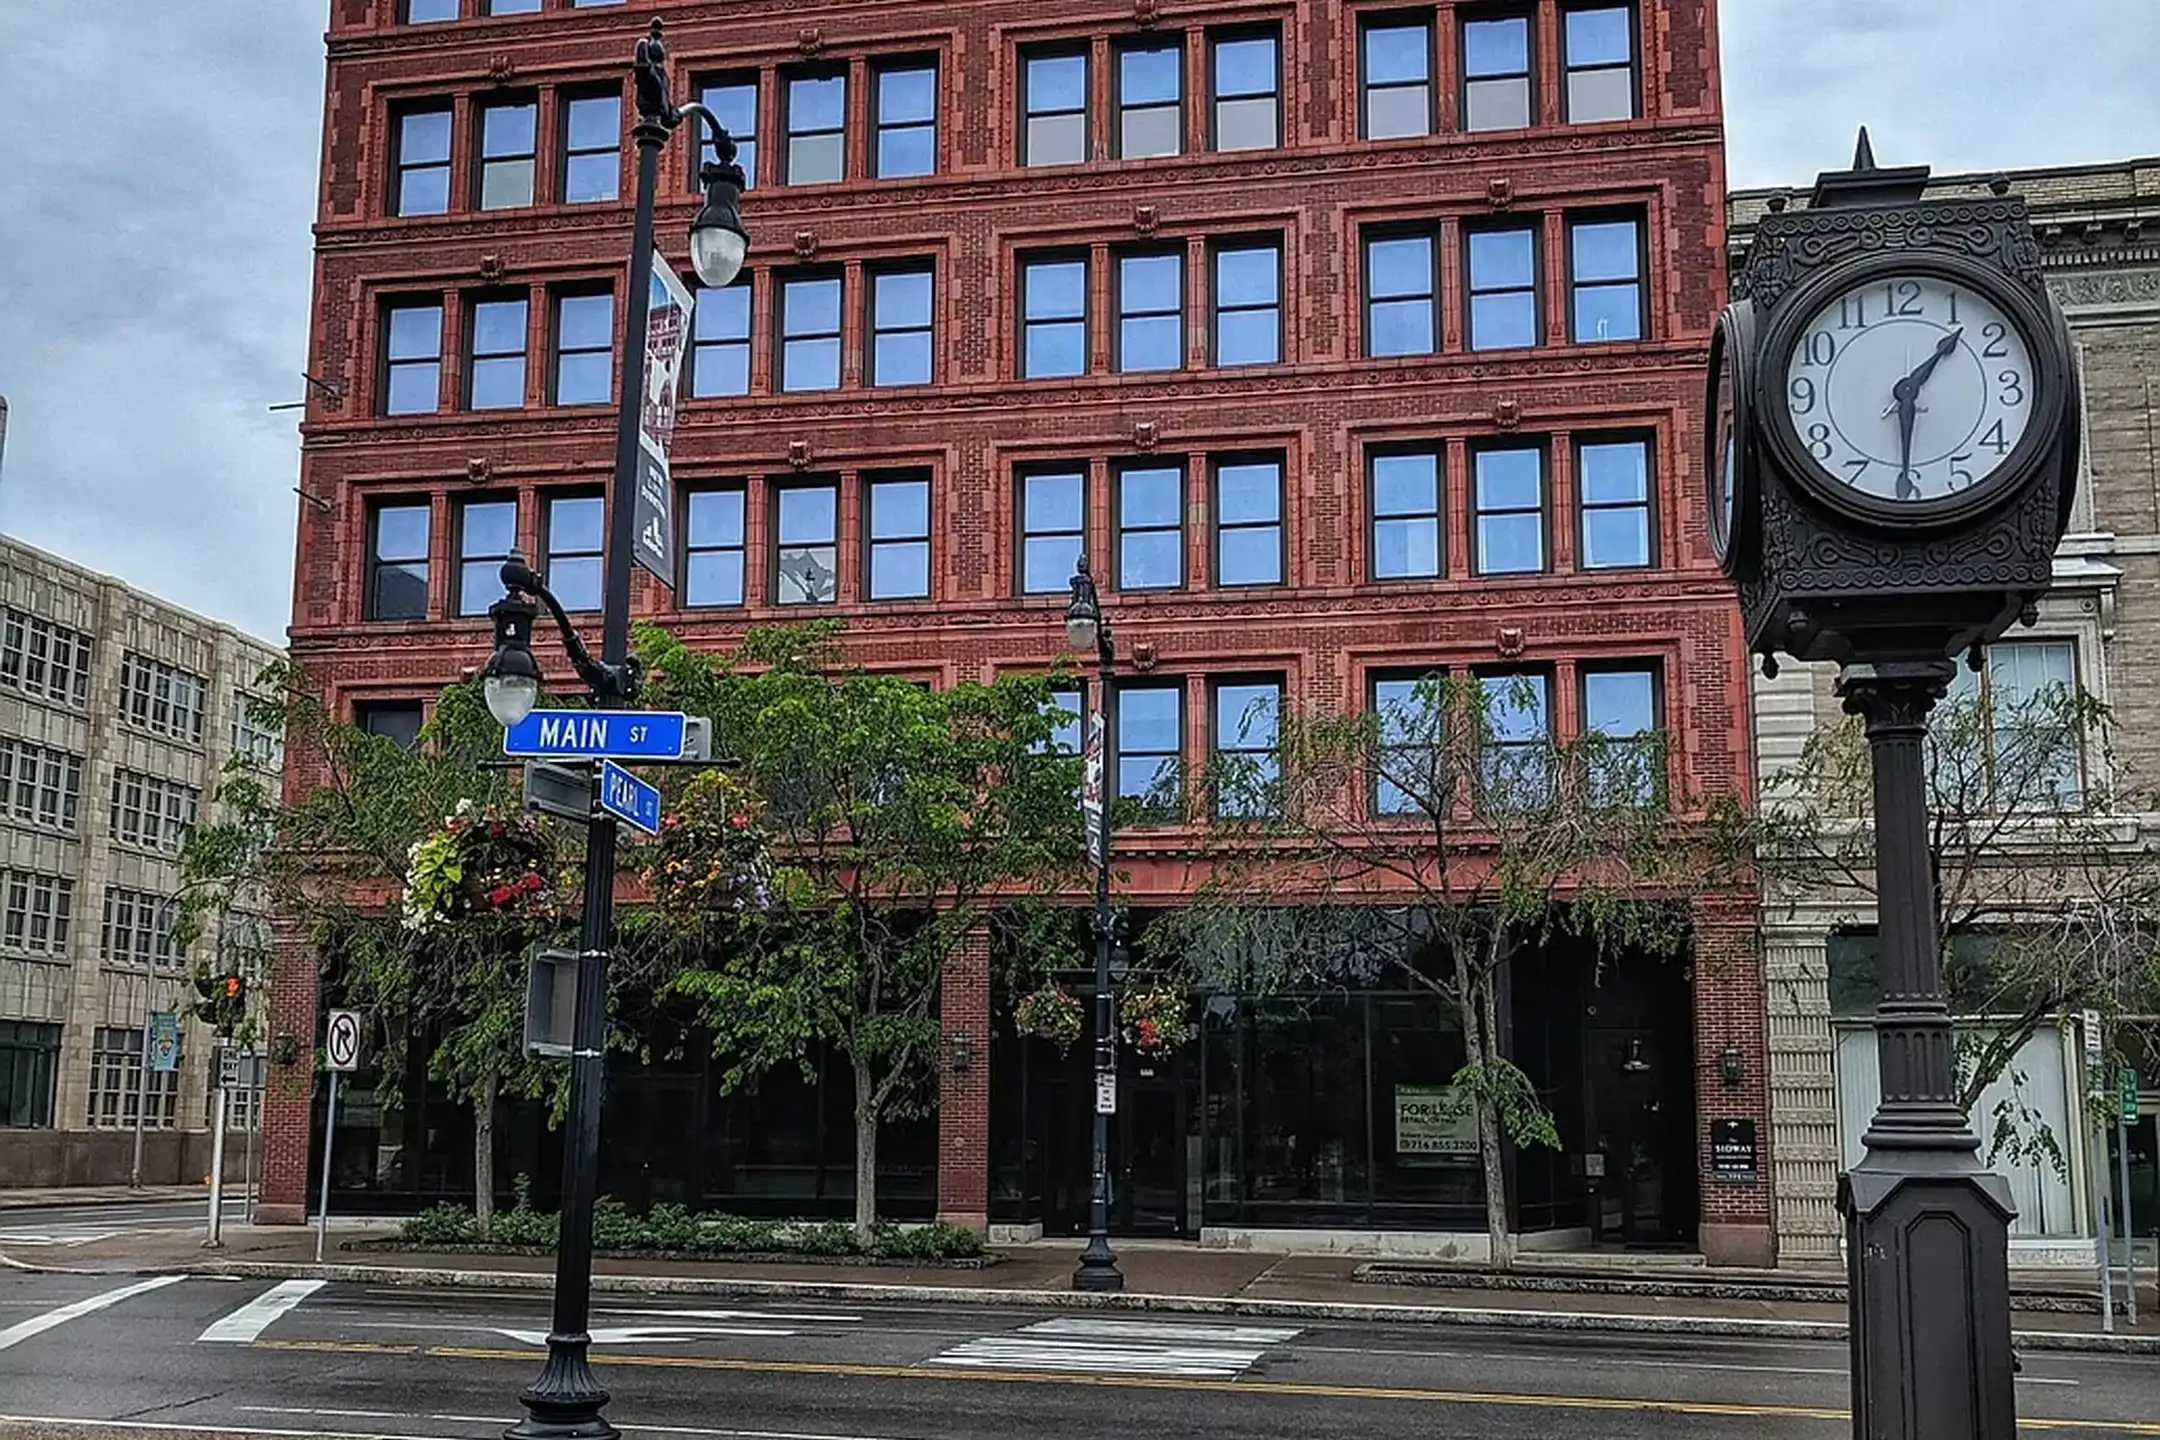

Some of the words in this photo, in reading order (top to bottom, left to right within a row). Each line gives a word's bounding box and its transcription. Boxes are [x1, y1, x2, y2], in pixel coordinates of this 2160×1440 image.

[1838, 294, 1868, 330] 11
[1883, 279, 1924, 317] 12
[1945, 292, 1961, 325] 1
[1801, 331, 1836, 366] 10
[1981, 322, 2008, 358] 2
[1790, 376, 1816, 415] 9
[1998, 370, 2024, 406] 3
[1808, 423, 1833, 460] 8
[1978, 418, 2010, 455] 4
[1842, 459, 1870, 487] 7
[1947, 452, 1974, 492] 5
[539, 717, 608, 749] MAIN
[629, 725, 649, 743] ST
[1400, 1104, 1429, 1116] FOR
